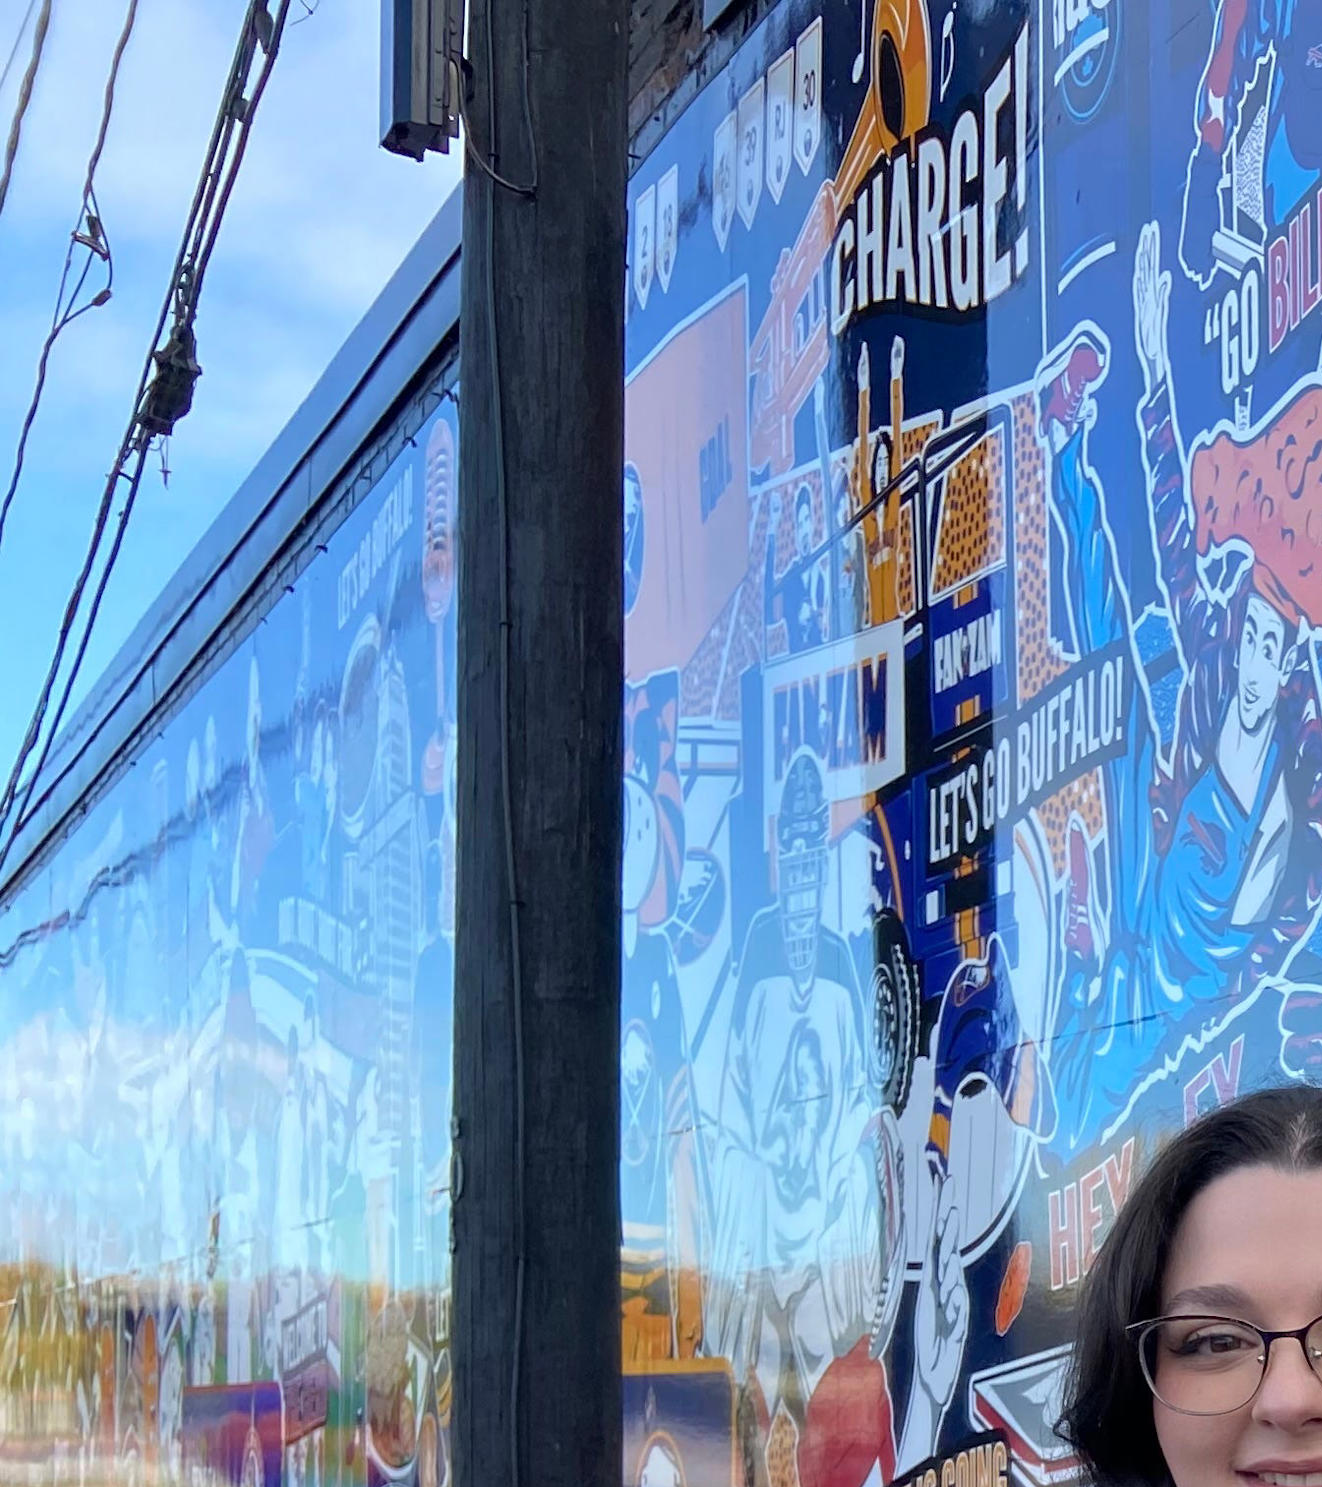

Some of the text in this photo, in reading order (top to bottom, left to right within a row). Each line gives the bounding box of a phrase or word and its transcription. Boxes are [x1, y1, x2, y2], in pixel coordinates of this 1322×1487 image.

[803, 69, 816, 111] 30
[831, 20, 1029, 337] CHARGE!
[930, 656, 1123, 863] LET'S GO BUFFALO!
[1048, 1136, 1135, 1291] HEY
